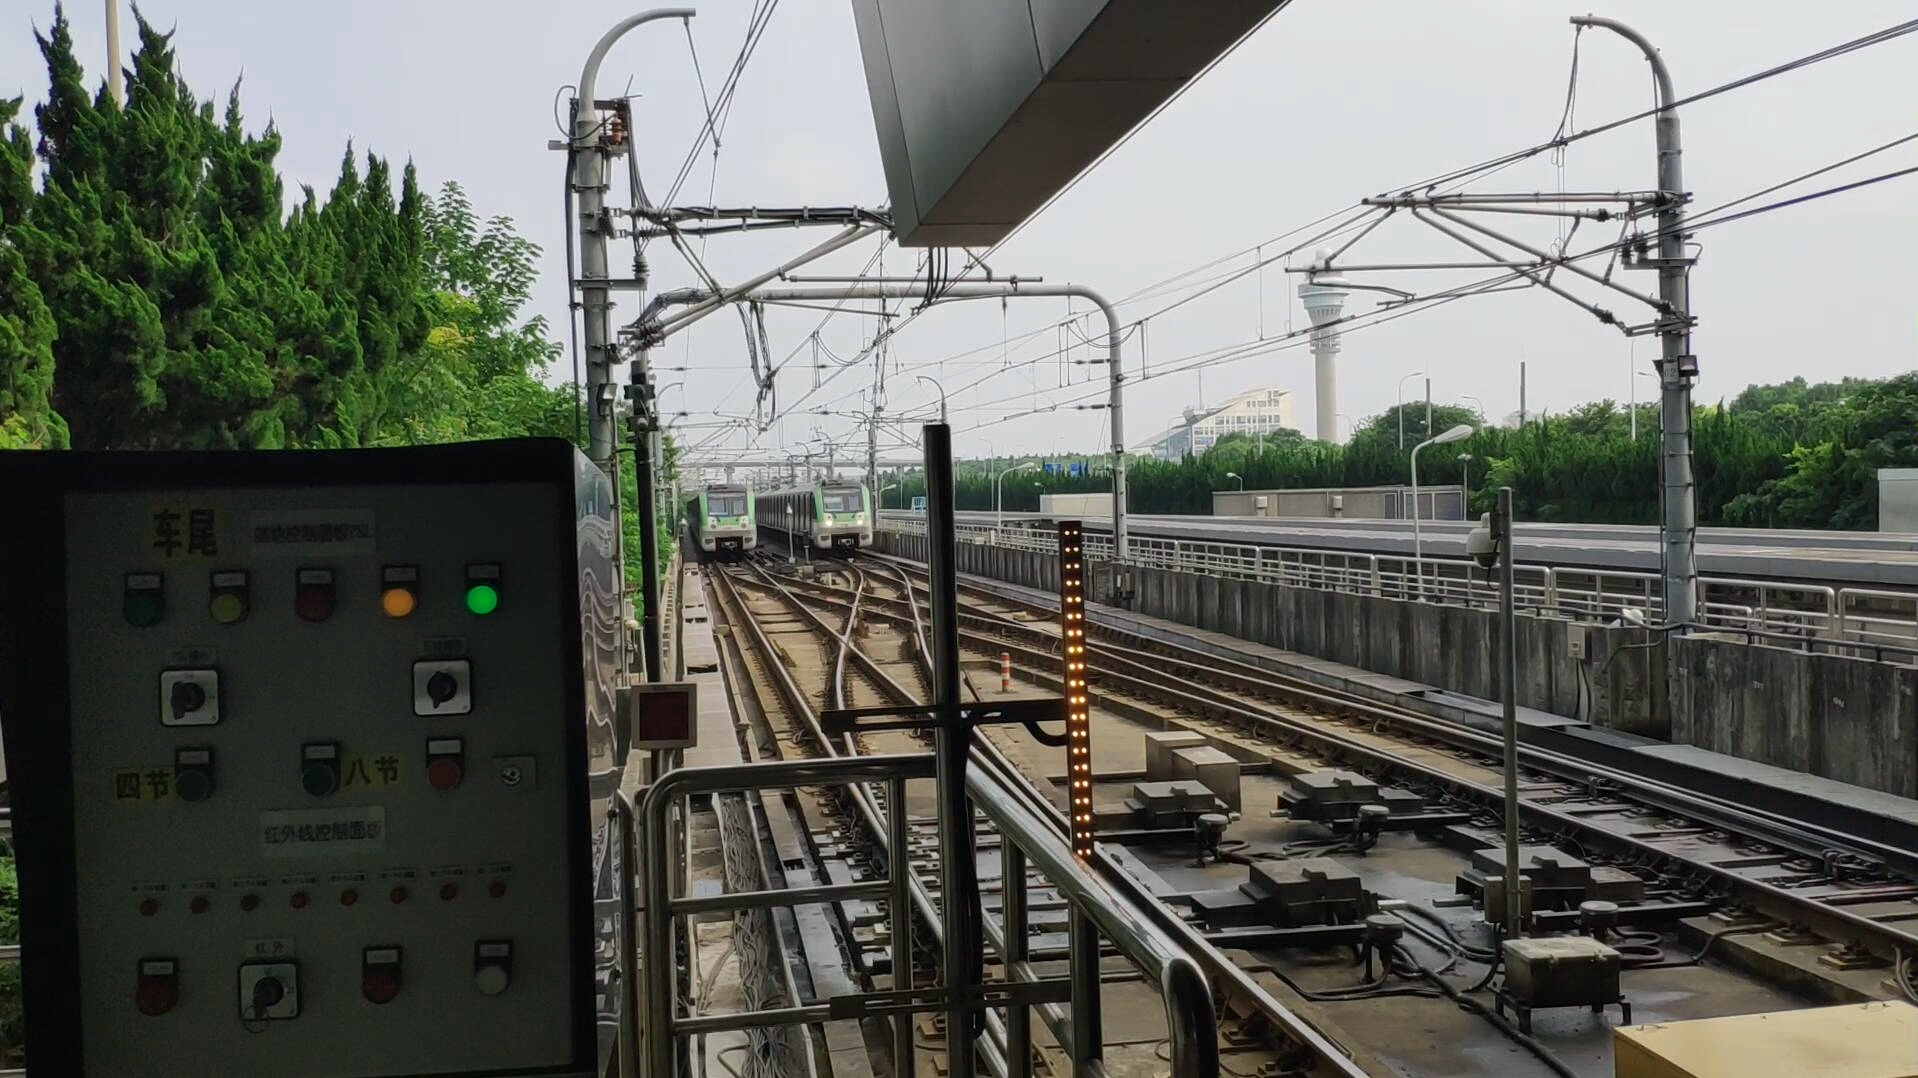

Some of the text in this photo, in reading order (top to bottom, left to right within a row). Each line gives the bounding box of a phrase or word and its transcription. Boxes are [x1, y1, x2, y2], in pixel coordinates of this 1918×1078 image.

[153, 508, 218, 557] 车尾
[117, 769, 171, 800] 四节
[345, 755, 400, 787] 八节
